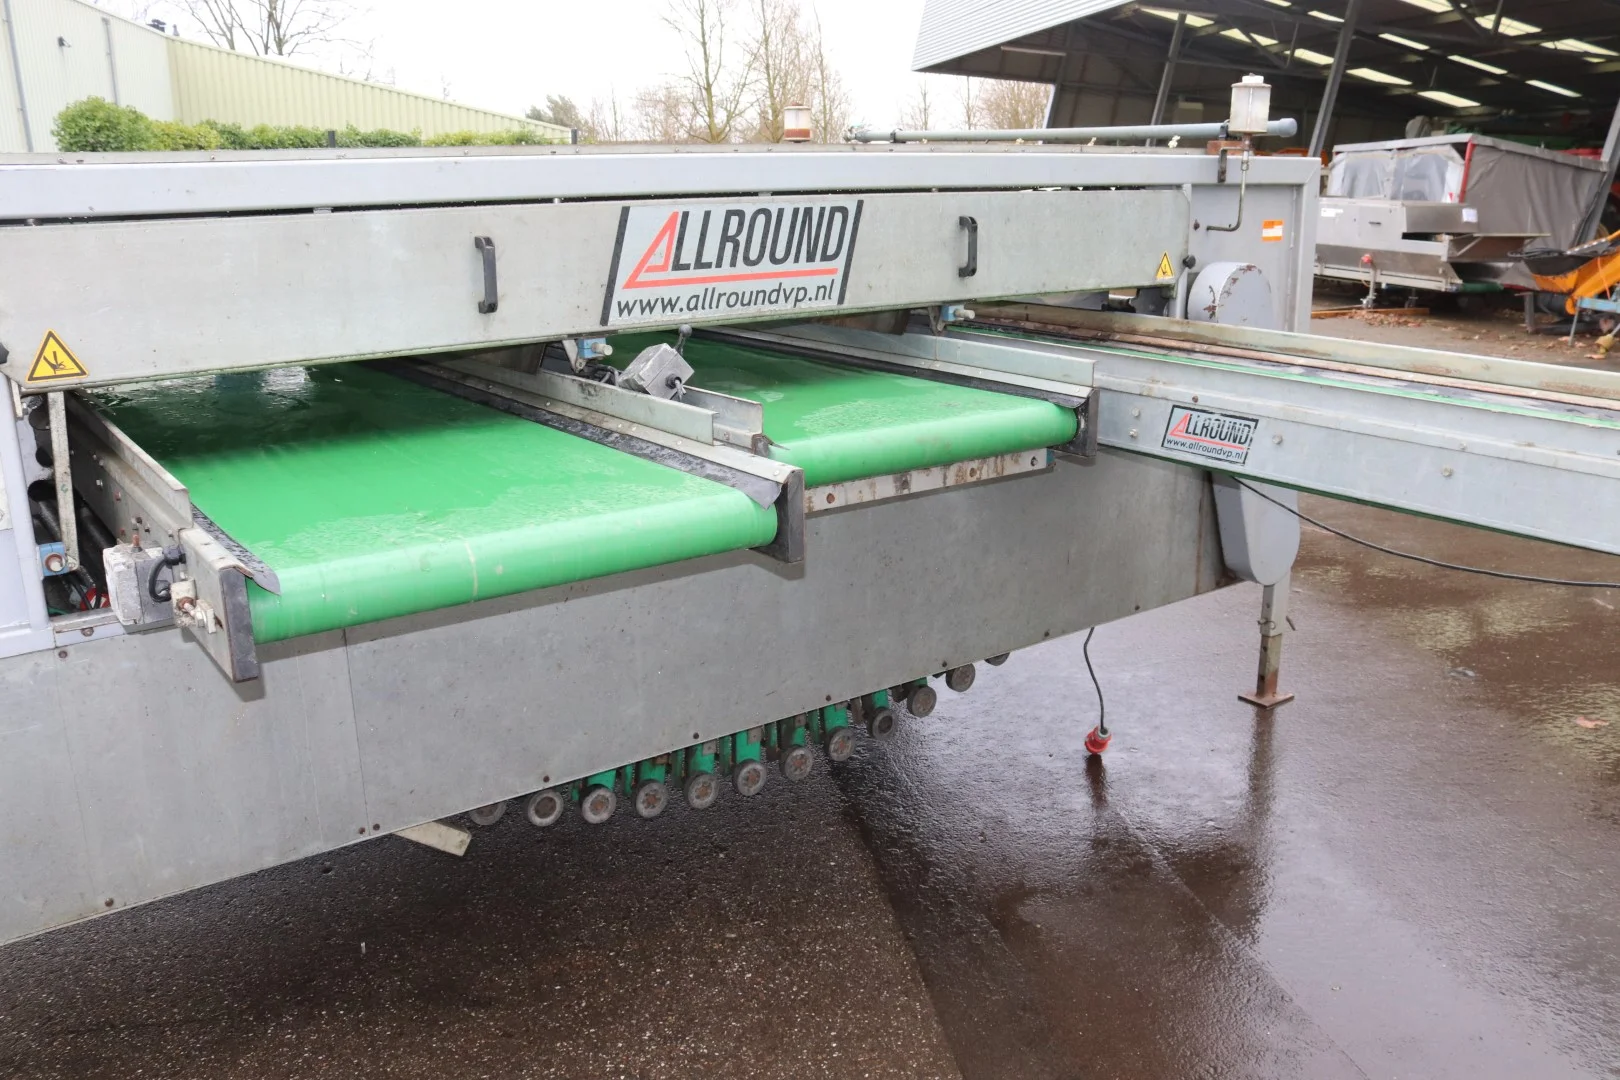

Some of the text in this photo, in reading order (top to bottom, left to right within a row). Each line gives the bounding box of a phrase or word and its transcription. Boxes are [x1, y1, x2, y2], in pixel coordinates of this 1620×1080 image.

[622, 206, 849, 289] ALLROUND
[617, 279, 835, 317] www.allroundvp.nl
[1170, 412, 1251, 446] ALLROUND
[1166, 438, 1244, 459] www.allroundvp.nl
